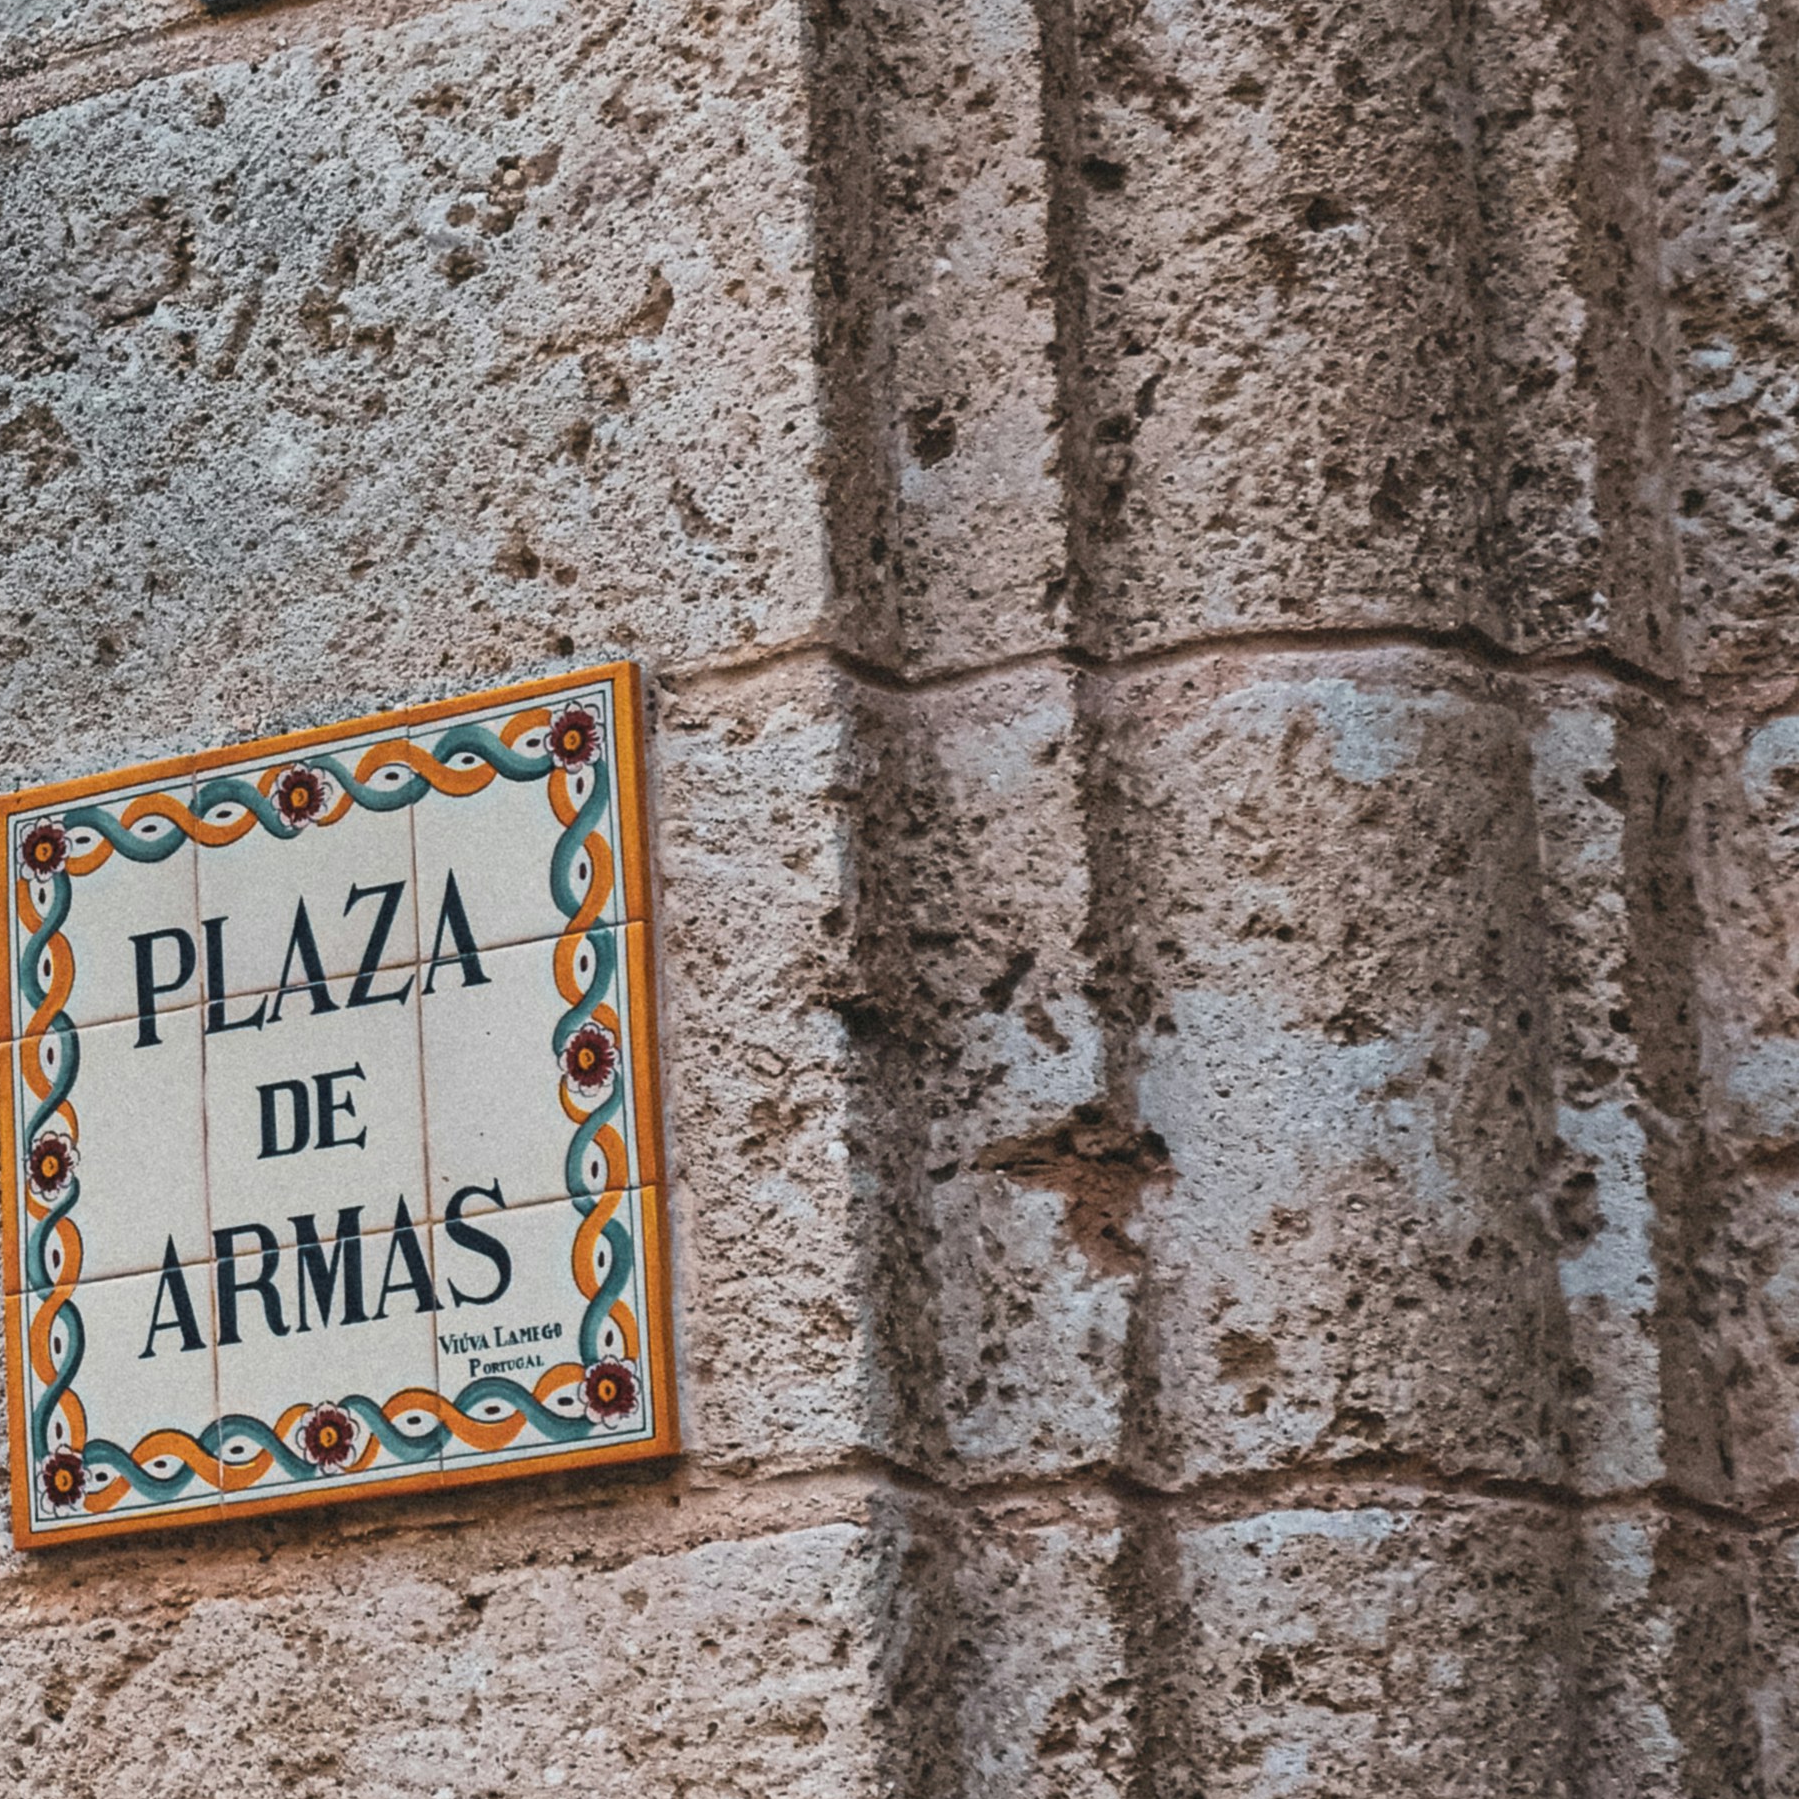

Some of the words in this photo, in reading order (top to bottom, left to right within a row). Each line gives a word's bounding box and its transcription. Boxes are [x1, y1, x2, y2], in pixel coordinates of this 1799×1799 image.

[129, 868, 492, 1048] PLAZA
[256, 1062, 367, 1160] DE
[139, 1178, 514, 1358] ARMAS
